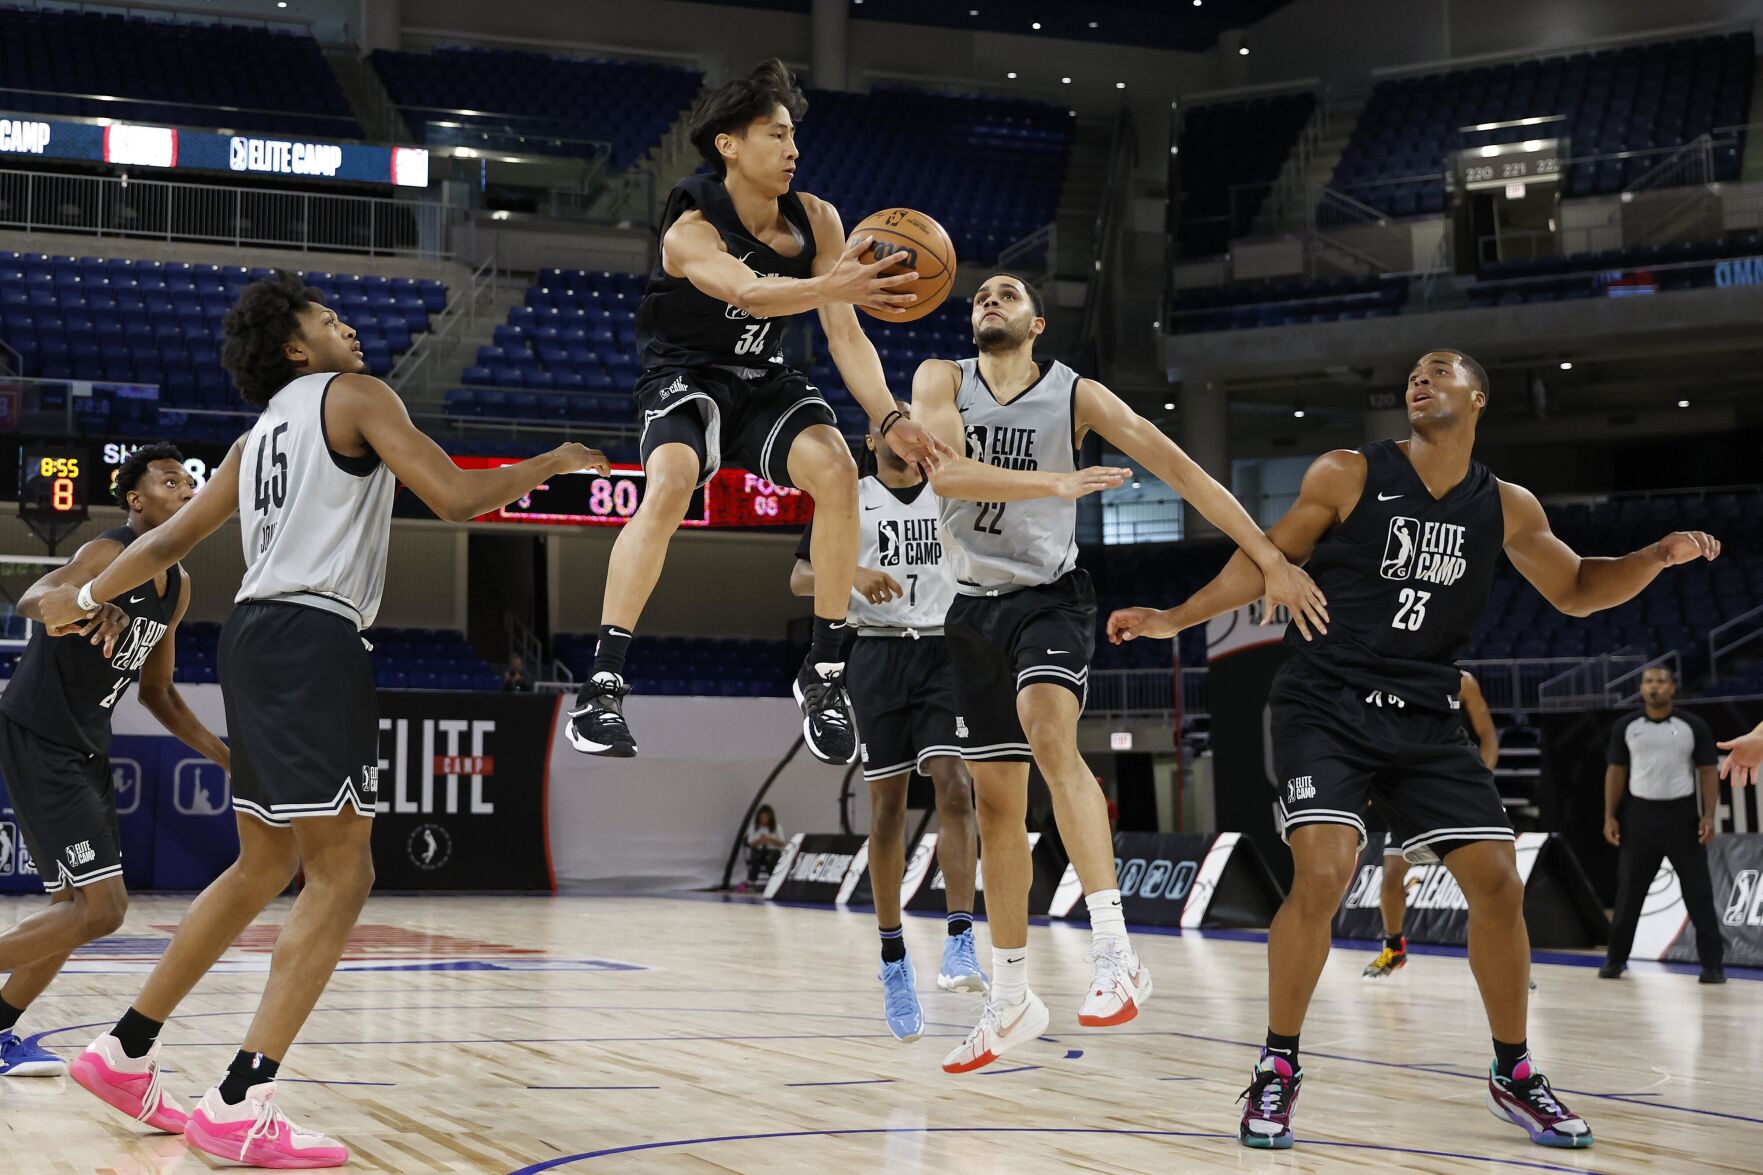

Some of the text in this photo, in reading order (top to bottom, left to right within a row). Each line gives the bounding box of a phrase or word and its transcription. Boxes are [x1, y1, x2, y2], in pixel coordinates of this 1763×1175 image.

[0, 119, 50, 154] CAMP
[248, 139, 342, 177] ELITE CAMP
[991, 426, 1036, 458] ELITE
[40, 457, 79, 478] 8:55
[254, 421, 288, 517] 45
[53, 477, 74, 511] 8
[589, 477, 638, 517] 80
[904, 518, 938, 542] ELITE
[973, 501, 1007, 536] 22
[905, 542, 942, 566] CAMP
[1421, 521, 1466, 557] ELITE
[1414, 552, 1467, 586] CAMP
[906, 574, 918, 607] 7
[1391, 587, 1432, 632] 23
[375, 718, 496, 814] ELITE
[1296, 775, 1313, 789] ELITE
[1296, 786, 1316, 800] CAMP
[74, 840, 91, 855] ELITE
[78, 849, 96, 865] CAMP
